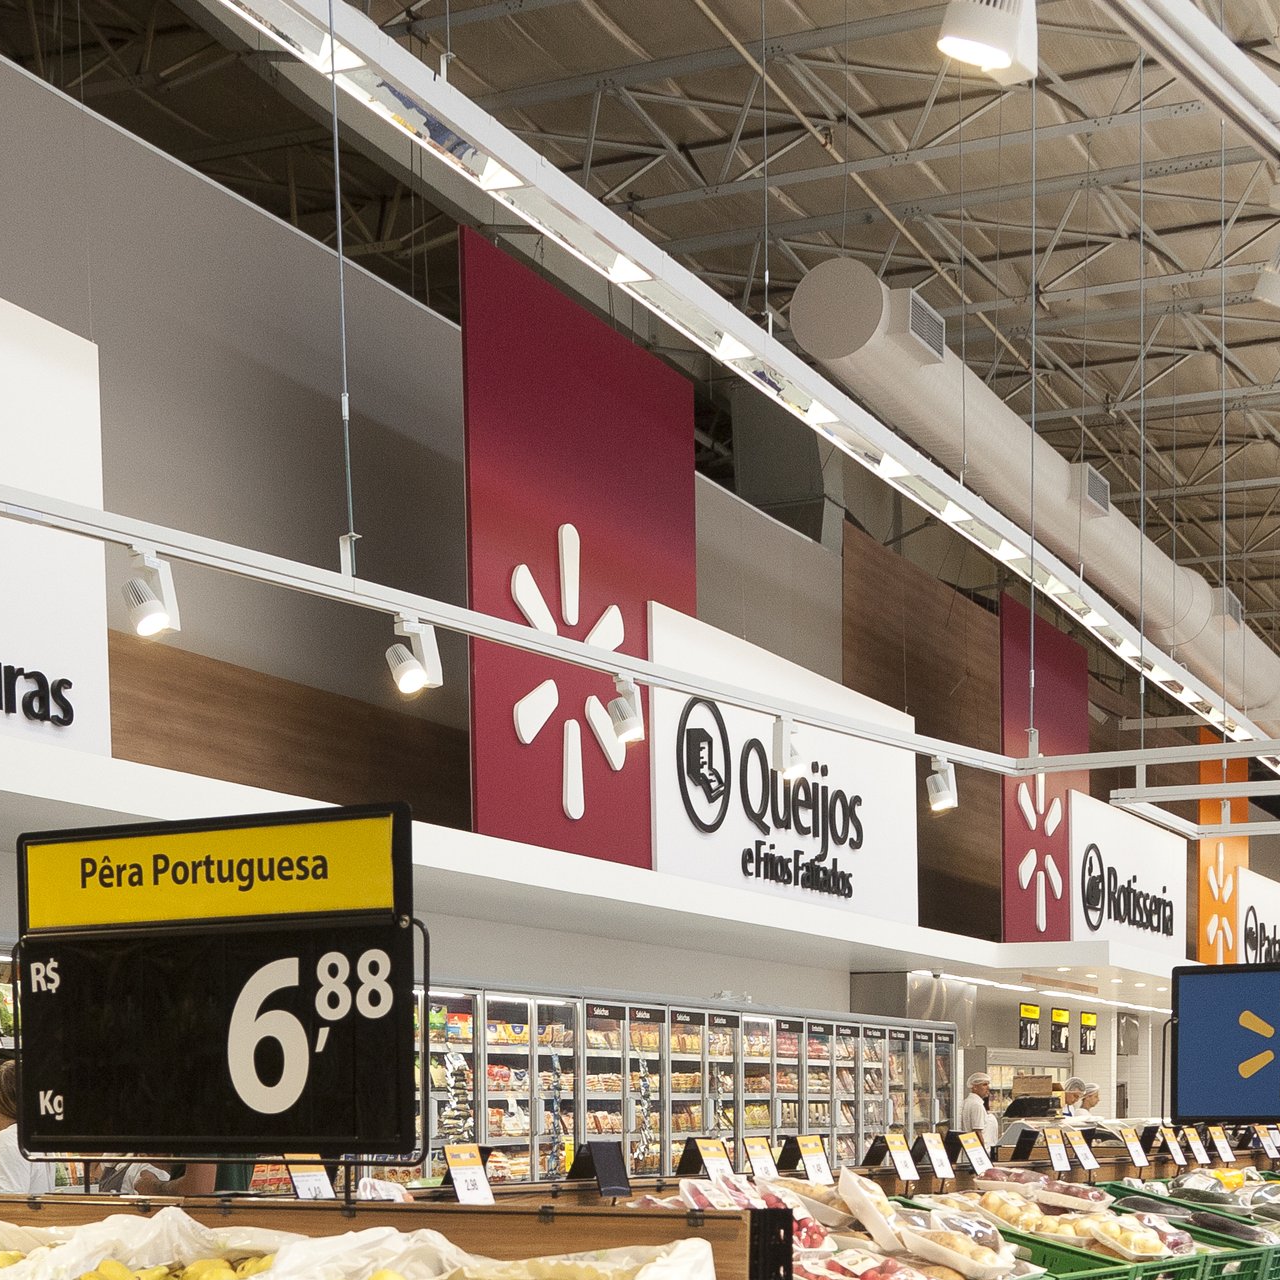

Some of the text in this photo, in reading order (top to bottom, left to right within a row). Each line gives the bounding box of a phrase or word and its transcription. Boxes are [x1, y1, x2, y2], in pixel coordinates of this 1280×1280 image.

[739, 737, 865, 863] Queijos
[80, 853, 329, 892] Pêra Portuguesa
[741, 847, 755, 877] e
[755, 839, 794, 885] Frios
[1107, 866, 1174, 937] Rotisseria
[30, 957, 60, 994] R$
[227, 948, 394, 1115] 6,88
[38, 1090, 64, 1121] Kg
